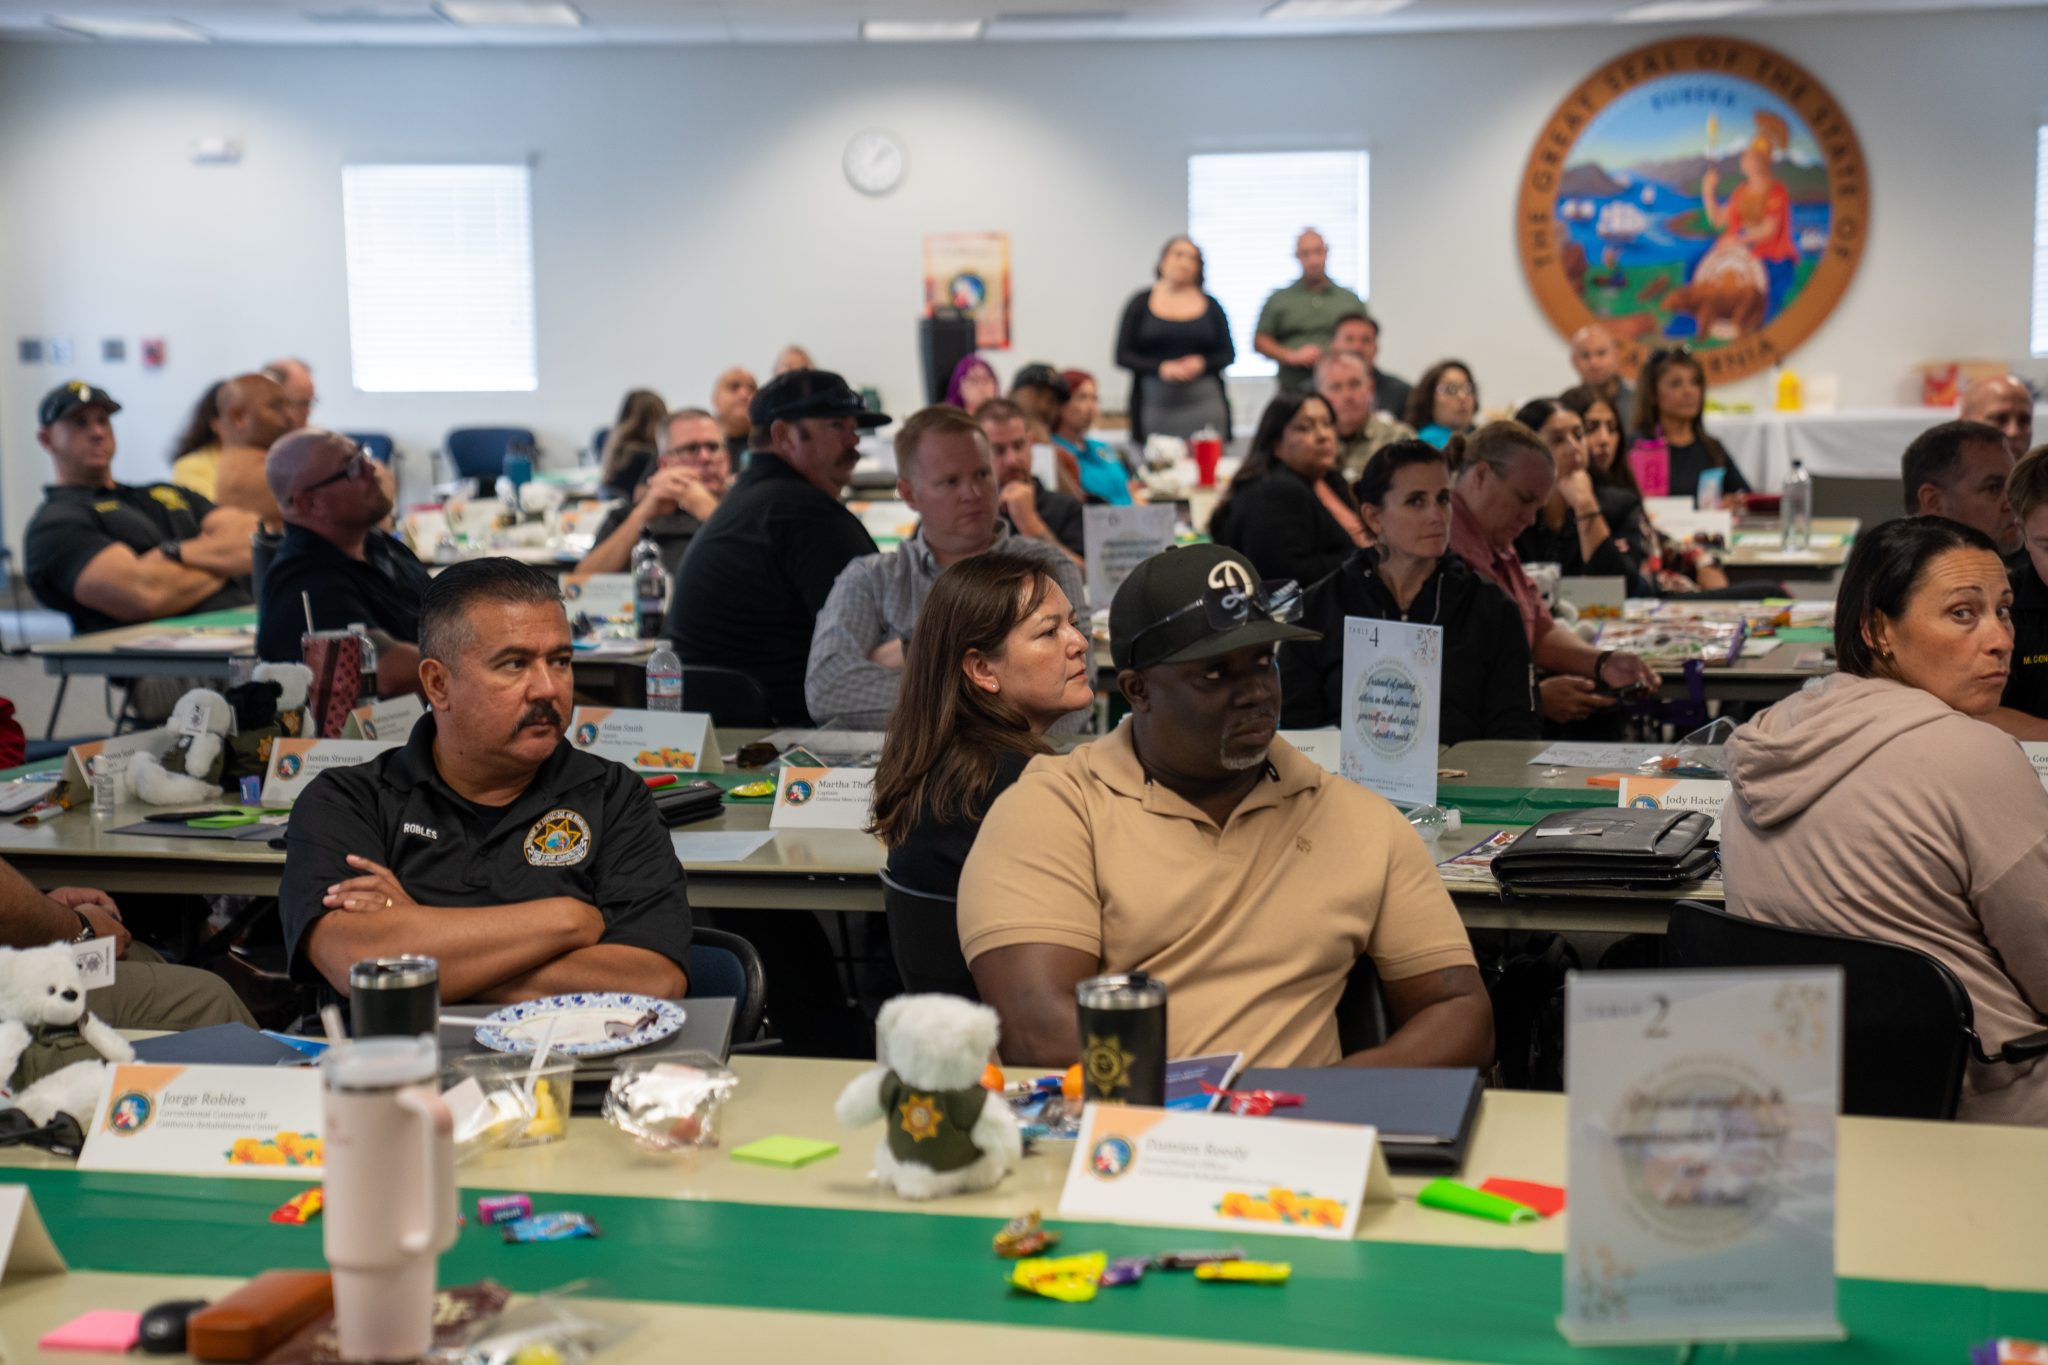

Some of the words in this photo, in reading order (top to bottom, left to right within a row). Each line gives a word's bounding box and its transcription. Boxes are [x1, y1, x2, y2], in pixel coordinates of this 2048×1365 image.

[1695, 48, 1738, 65] OF
[1605, 52, 1676, 91] SEAL
[1756, 53, 1807, 101] THE
[1651, 87, 1736, 111] EUREKA
[1531, 93, 1594, 192] GREAT
[1812, 104, 1857, 197] STATE
[1529, 212, 1548, 268] THE
[1834, 216, 1858, 258] OF
[1368, 626, 1379, 648] 4
[623, 723, 644, 733] Smith
[307, 753, 330, 763] Justin
[818, 780, 850, 789] Martha
[1666, 795, 1688, 805] Jody
[403, 822, 438, 840] ROBLES
[1642, 994, 1672, 1039] 2
[162, 1091, 198, 1107] Jorge
[200, 1092, 247, 1107] Robles
